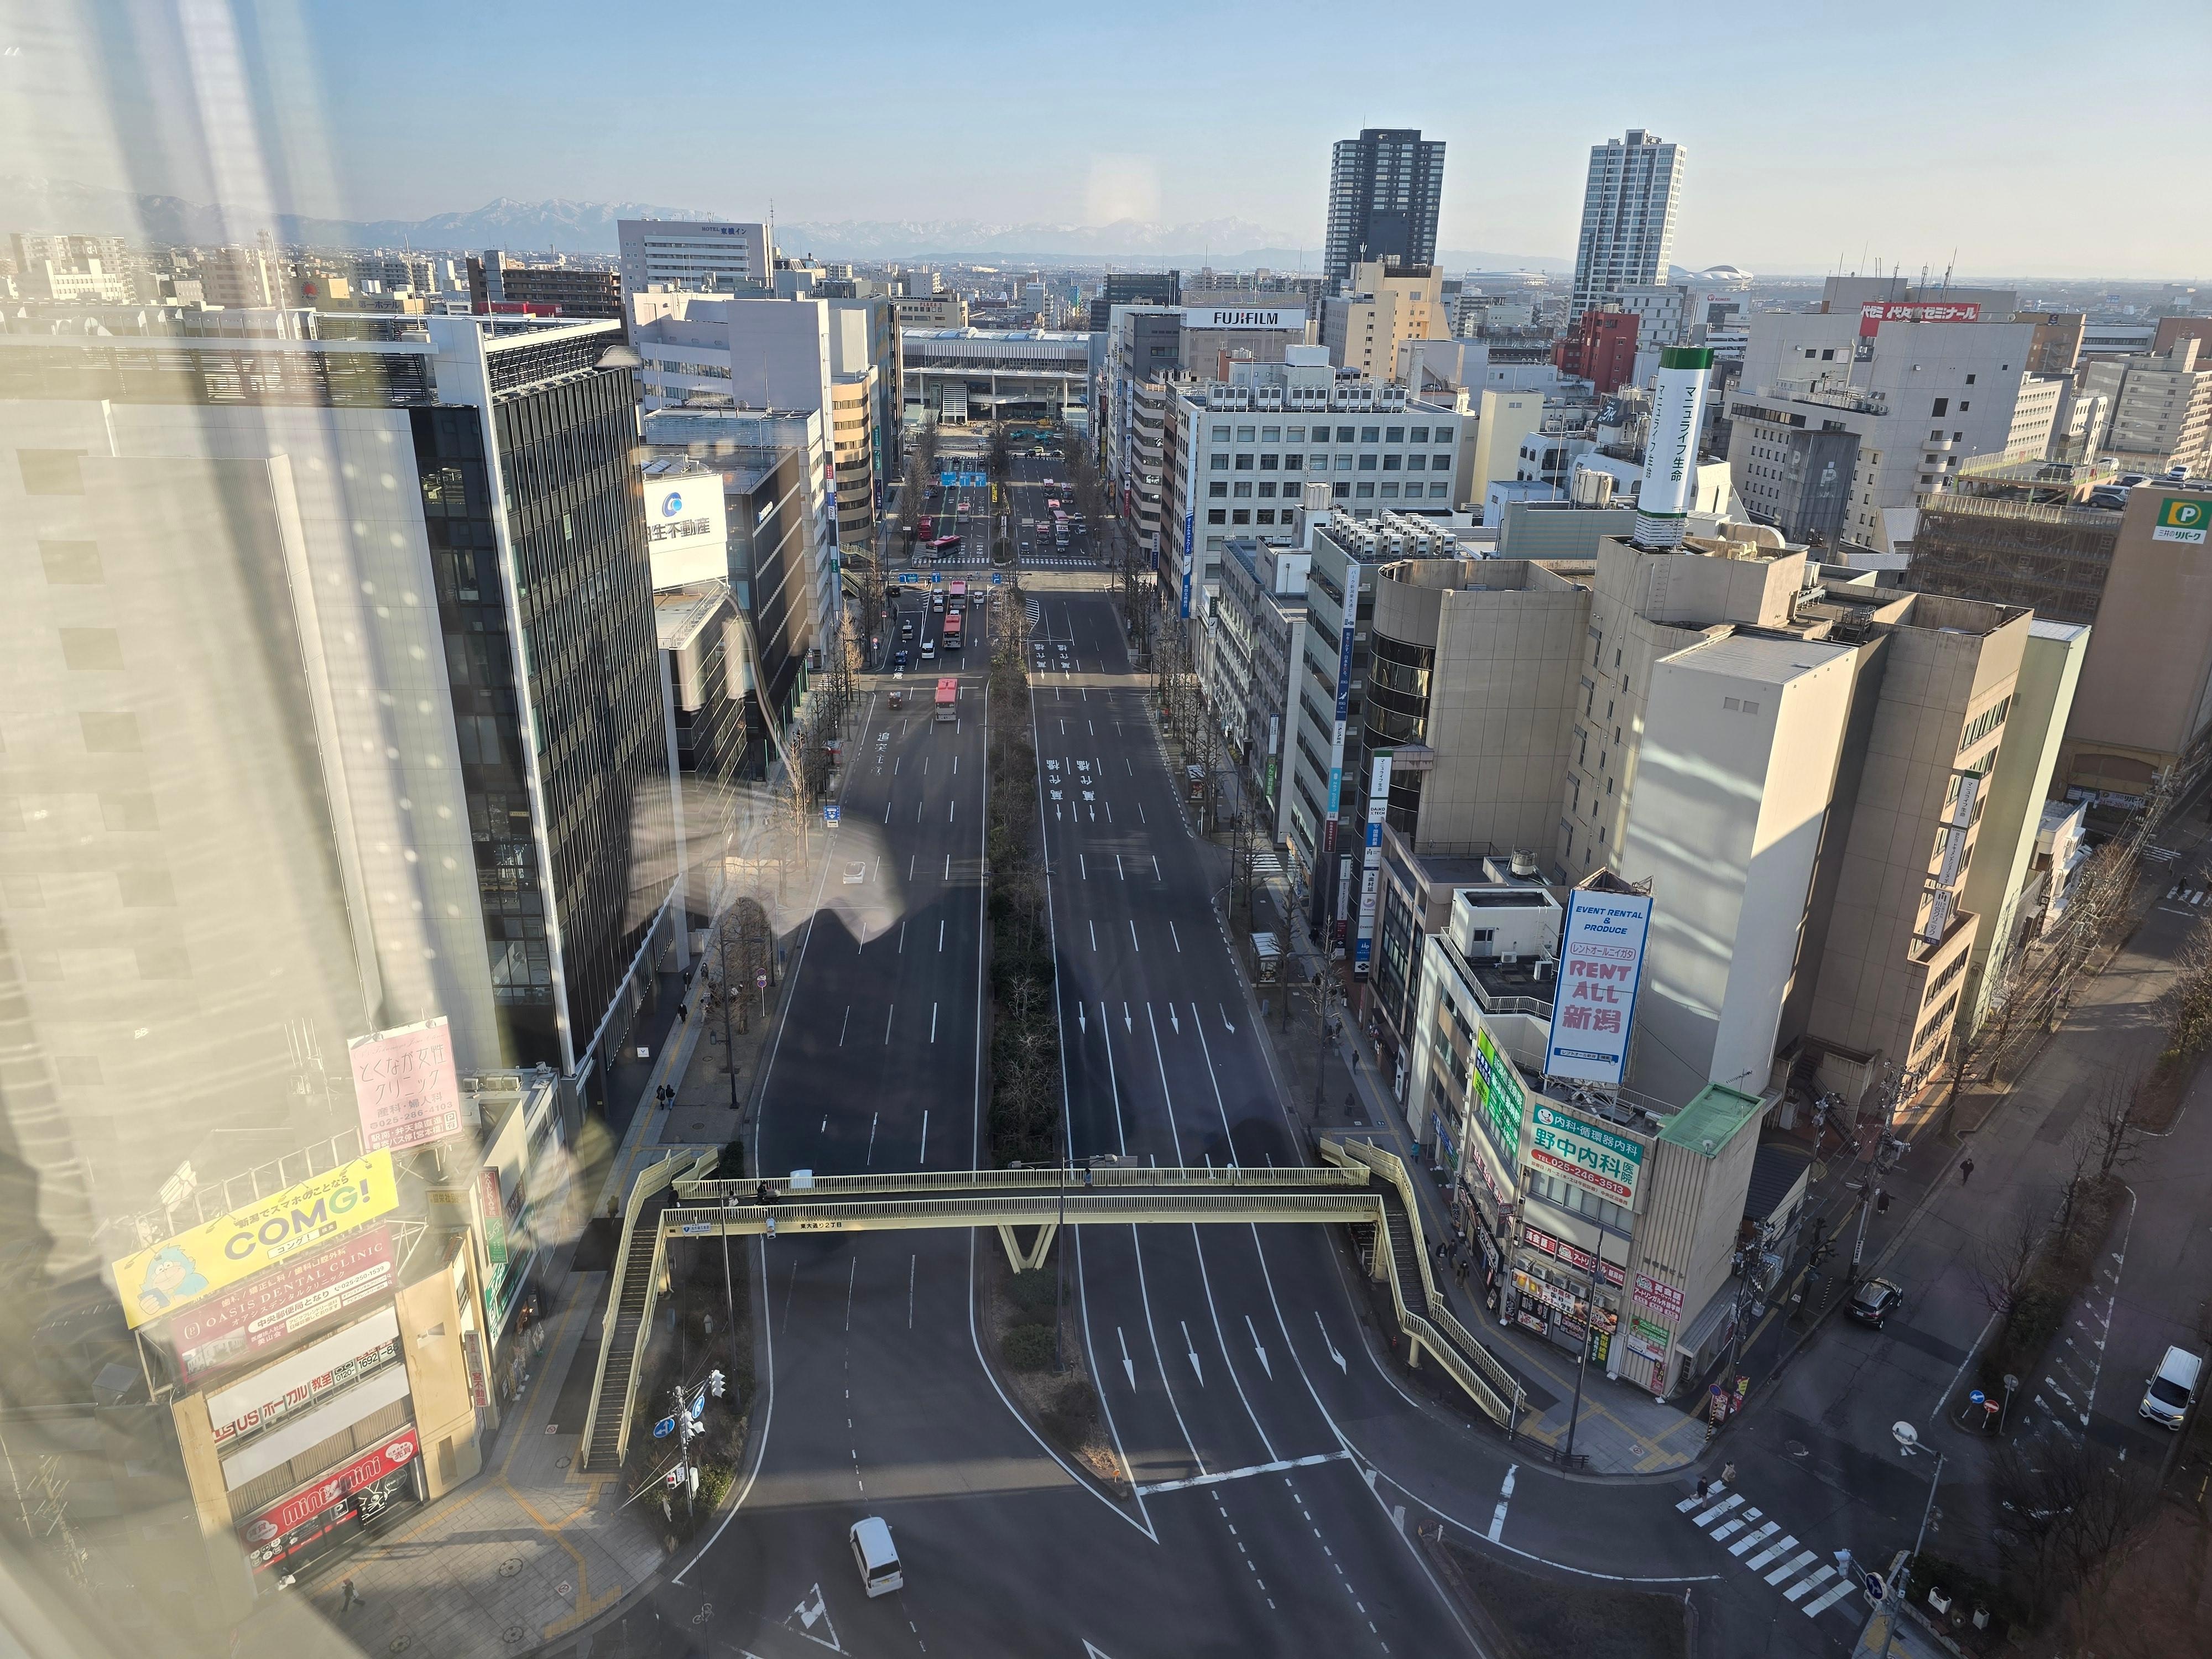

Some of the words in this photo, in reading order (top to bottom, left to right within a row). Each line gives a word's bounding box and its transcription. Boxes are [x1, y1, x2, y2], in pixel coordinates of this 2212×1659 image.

[1214, 312, 1278, 325] FUJIFILM
[1887, 306, 1976, 320] 代々ゼミナール
[1646, 385, 1665, 479] マニュライフ生命
[1671, 387, 1696, 482] マニュライフ生命
[2181, 507, 2196, 521] P
[2158, 530, 2201, 541] 三井のリパーク
[1347, 570, 1355, 617] パーク新潟東大通ビル
[1377, 759, 1385, 792] マニュライフ生命
[1959, 781, 1973, 817] マニュライフ生命
[1576, 906, 1606, 915] EVENT
[1608, 909, 1643, 919] RENTAL
[1584, 924, 1628, 935] PRODUCE
[1572, 943, 1633, 959] レントオールニイガタ
[1569, 960, 1632, 982] RENT
[1572, 980, 1619, 1004] ALL
[1562, 1004, 1621, 1034] 新潟
[359, 1044, 447, 1083] とくなが女性
[375, 1070, 439, 1105] クリニック
[377, 1092, 443, 1119] 産科・婦人科
[379, 1101, 453, 1128] 025-286-4103
[1554, 1116, 1637, 1156] 内科・循環器内科
[1534, 1128, 1621, 1178] 野中内科
[1621, 1162, 1635, 1185] 医院
[233, 1175, 349, 1229] 新潟でスマホのことなら
[224, 1178, 371, 1260] COMG!
[1573, 1253, 1607, 1274] アートリンル
[206, 1299, 255, 1328] OASIS
[261, 1269, 326, 1305] DENTAL
[330, 1242, 384, 1272] CLINIC
[232, 1271, 345, 1327] オアシスデンタルクリニック
[1654, 1282, 1682, 1301] 英会話
[257, 1290, 330, 1328] 中央郵便局となり
[472, 1372, 486, 1406] 宮不動産
